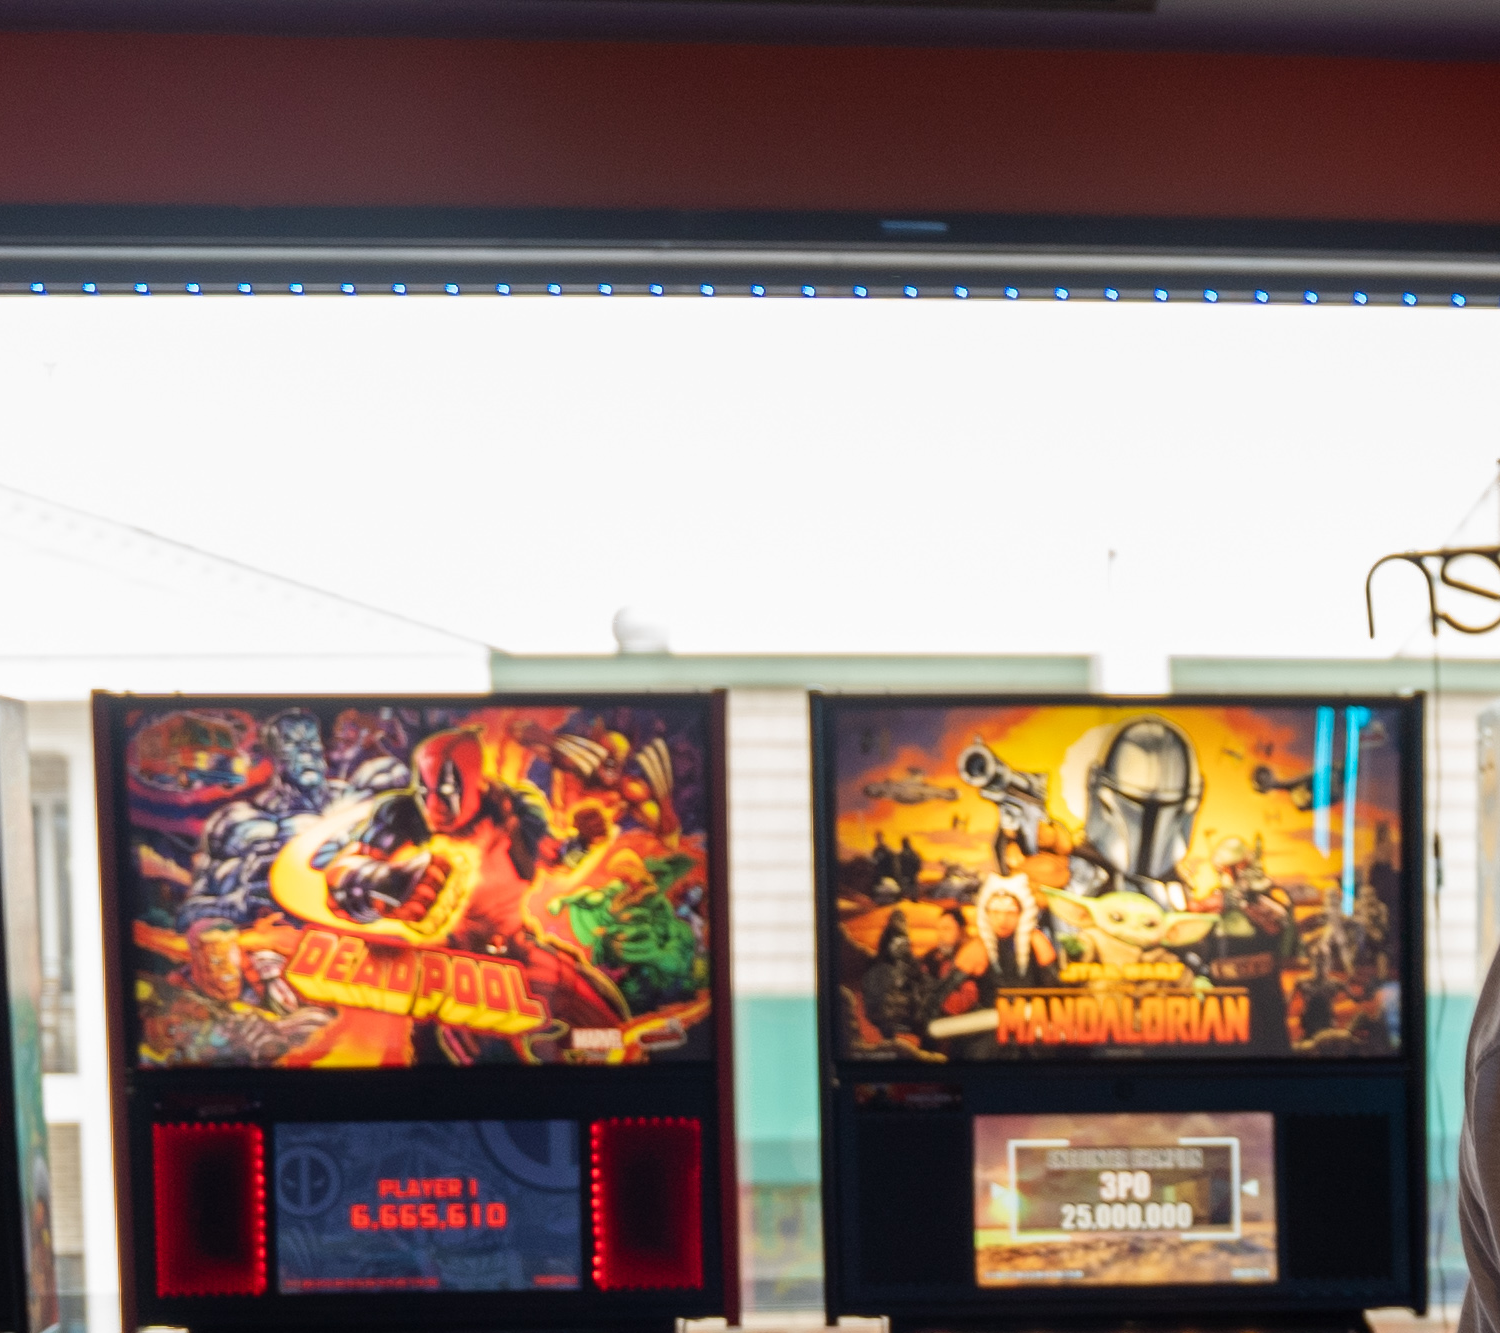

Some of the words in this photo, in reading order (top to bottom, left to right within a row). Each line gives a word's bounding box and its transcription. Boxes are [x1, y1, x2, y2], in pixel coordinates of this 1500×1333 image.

[287, 928, 548, 1033] DEADPOOL
[996, 996, 1248, 1044] MANDALORIAN
[377, 1178, 463, 1198] PLAYER
